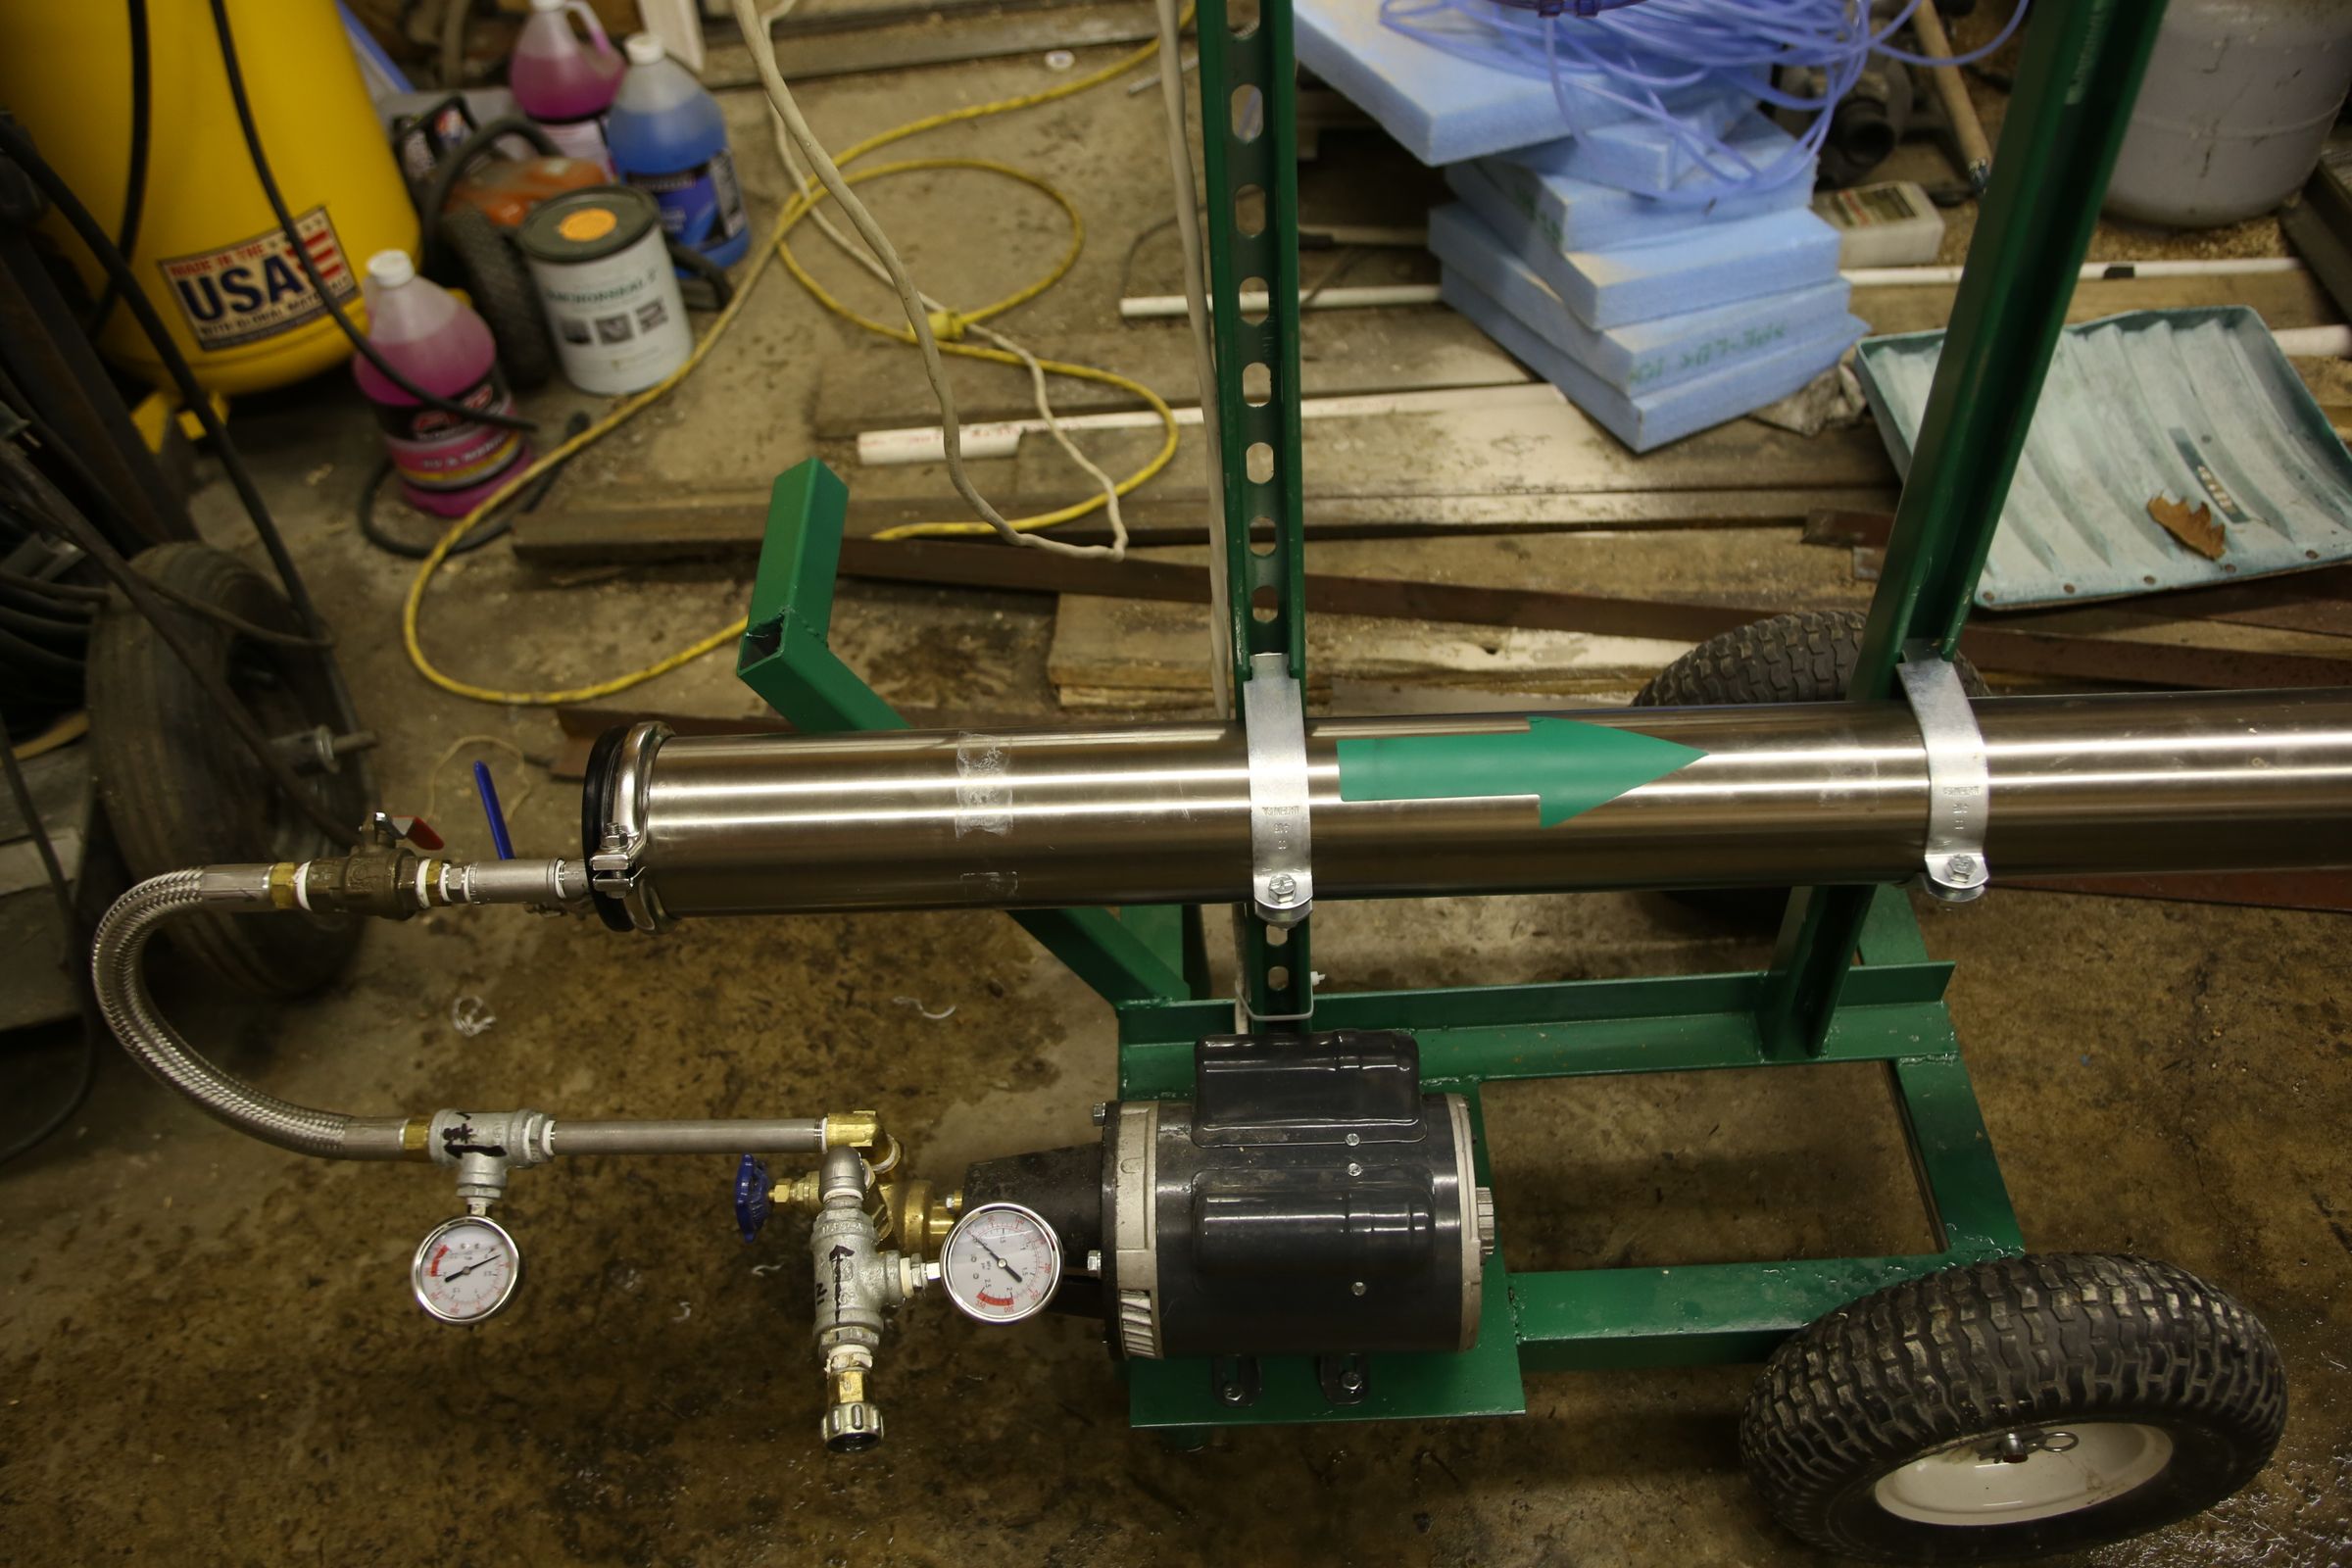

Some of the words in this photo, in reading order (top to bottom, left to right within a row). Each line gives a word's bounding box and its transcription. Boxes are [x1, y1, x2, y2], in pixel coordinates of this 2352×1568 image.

[171, 260, 213, 275] MADE
[217, 253, 234, 267] IN
[237, 244, 267, 262] THE
[177, 255, 304, 320] USA
